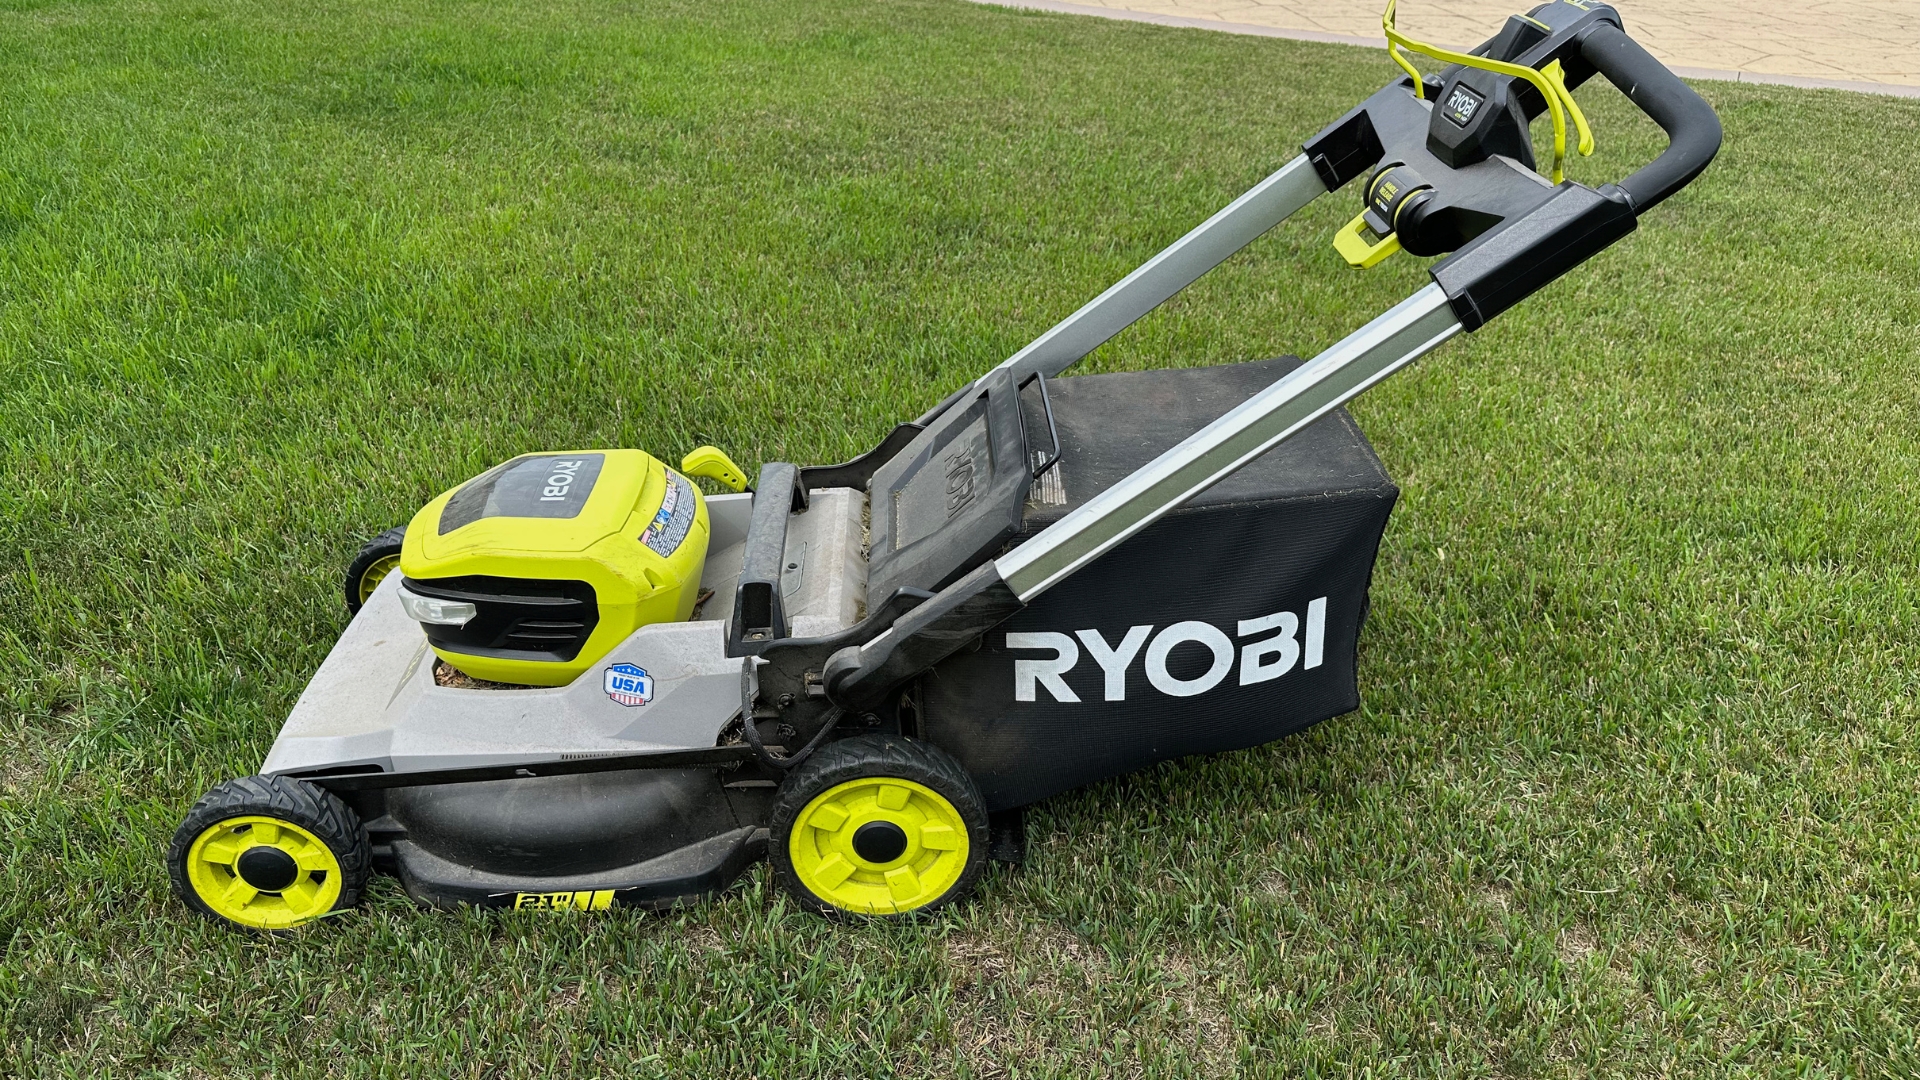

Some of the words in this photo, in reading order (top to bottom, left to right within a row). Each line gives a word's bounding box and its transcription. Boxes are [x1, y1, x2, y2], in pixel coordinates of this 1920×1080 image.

[1448, 90, 1478, 117] RYOBI
[540, 461, 583, 501] RYOBI
[1005, 596, 1327, 703] RYOBI
[612, 676, 645, 694] USA
